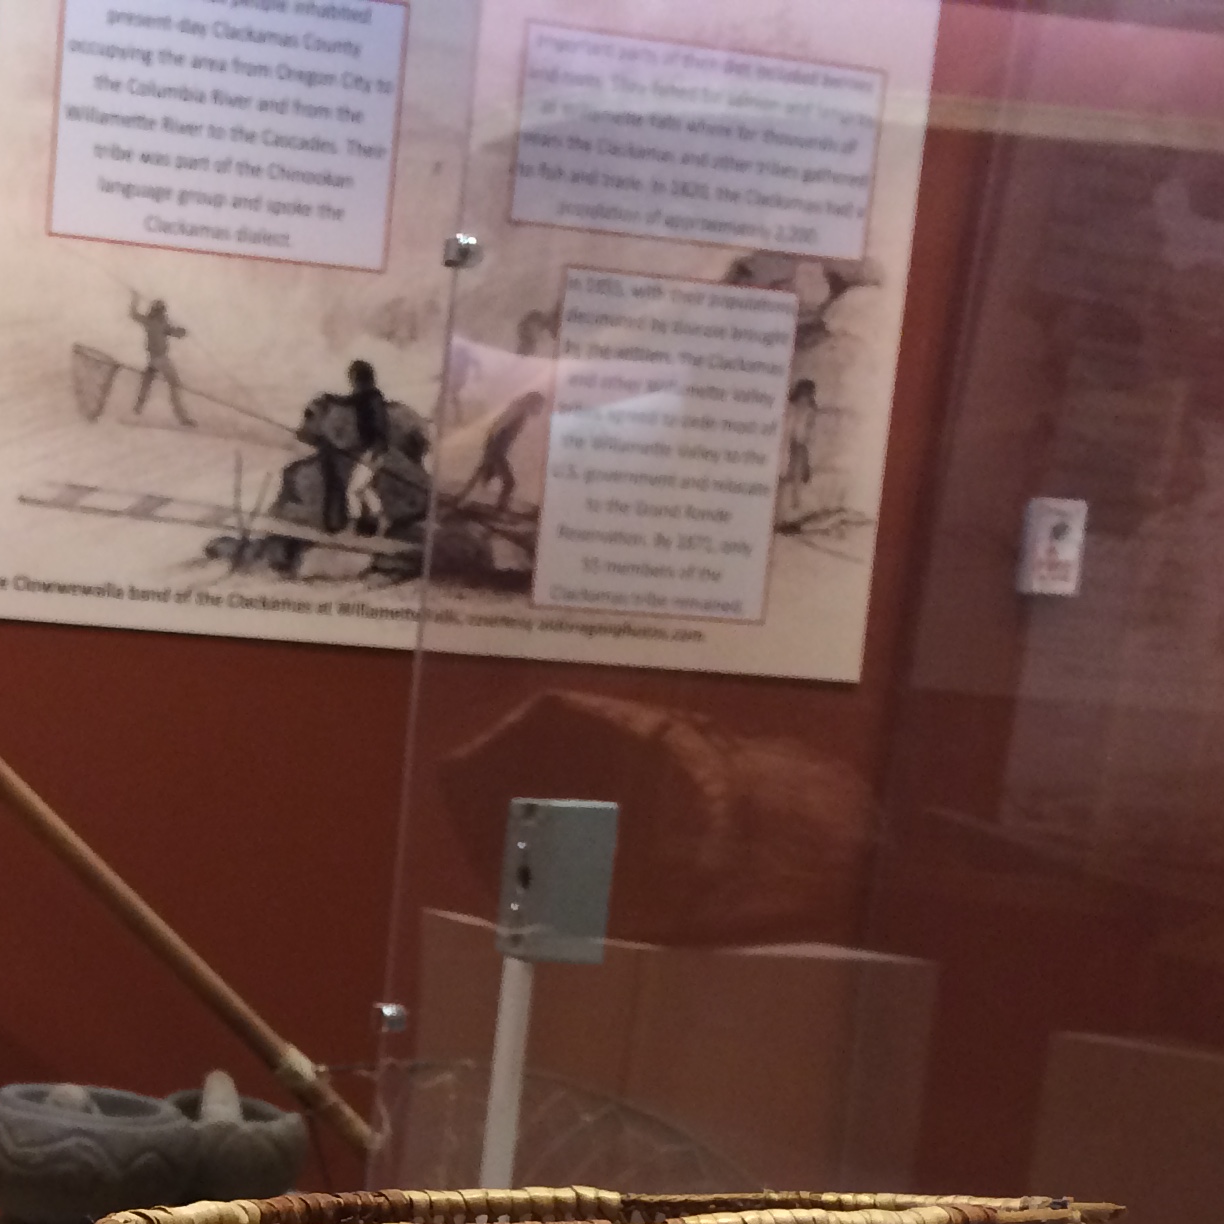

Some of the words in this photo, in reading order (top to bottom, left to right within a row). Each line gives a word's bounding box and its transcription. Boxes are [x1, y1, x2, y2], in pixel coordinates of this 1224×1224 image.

[212, 20, 298, 48] Clackamas
[303, 32, 362, 59] County
[69, 38, 154, 66] occupying
[158, 49, 184, 66] the
[191, 54, 228, 72] area
[231, 57, 271, 77] from
[276, 62, 336, 87] Oregon
[341, 71, 371, 93] City
[377, 79, 393, 95] to
[93, 74, 121, 92] the
[126, 77, 206, 103] Columbia
[211, 89, 253, 109] River
[257, 97, 288, 115] and
[292, 98, 332, 119] from
[336, 105, 364, 123] the
[65, 104, 157, 130] Willamette
[162, 116, 204, 136] River
[207, 123, 227, 139] to
[230, 124, 256, 144] the
[347, 138, 387, 159] Their
[93, 142, 133, 162] tribe
[139, 152, 170, 167] was
[175, 155, 210, 172] part
[214, 158, 232, 174] of
[235, 159, 263, 178] the
[267, 162, 355, 188] Chinookan
[97, 176, 173, 201] language
[178, 188, 228, 208] group
[232, 195, 262, 212] and
[266, 197, 312, 217] spoke
[317, 202, 345, 221] the
[143, 214, 230, 243] Clackamas
